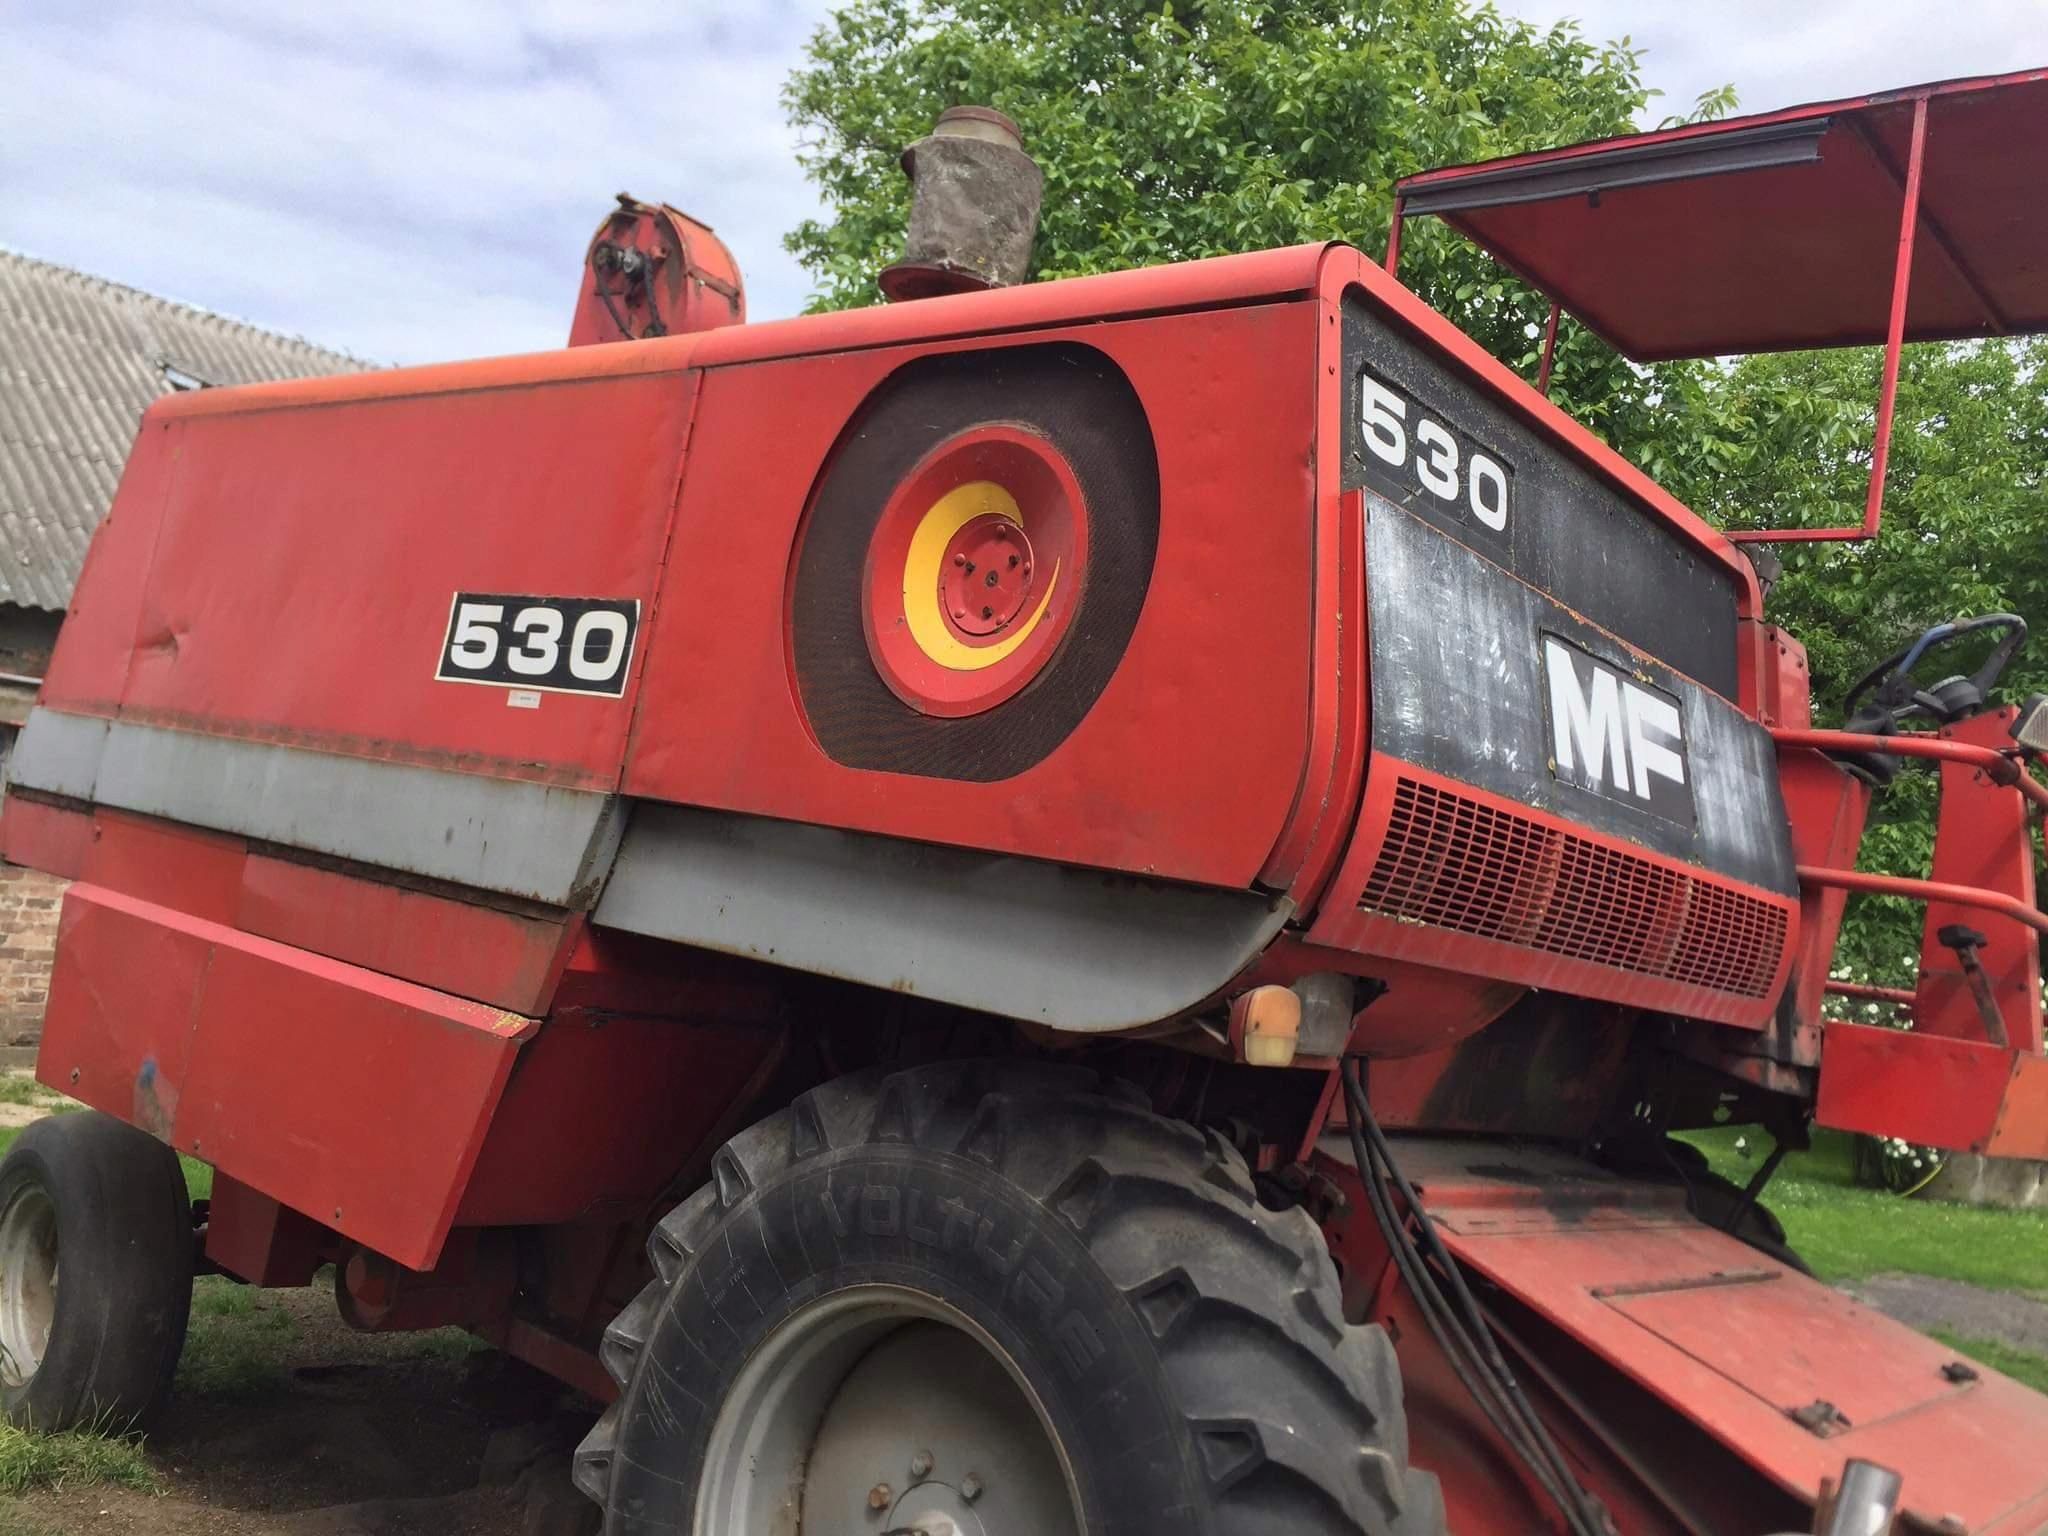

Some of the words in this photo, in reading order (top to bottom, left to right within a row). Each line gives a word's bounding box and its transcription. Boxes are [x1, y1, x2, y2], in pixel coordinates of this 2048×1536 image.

[1361, 374, 1508, 532] 530
[450, 603, 628, 681] 530
[1545, 639, 1685, 800] MF
